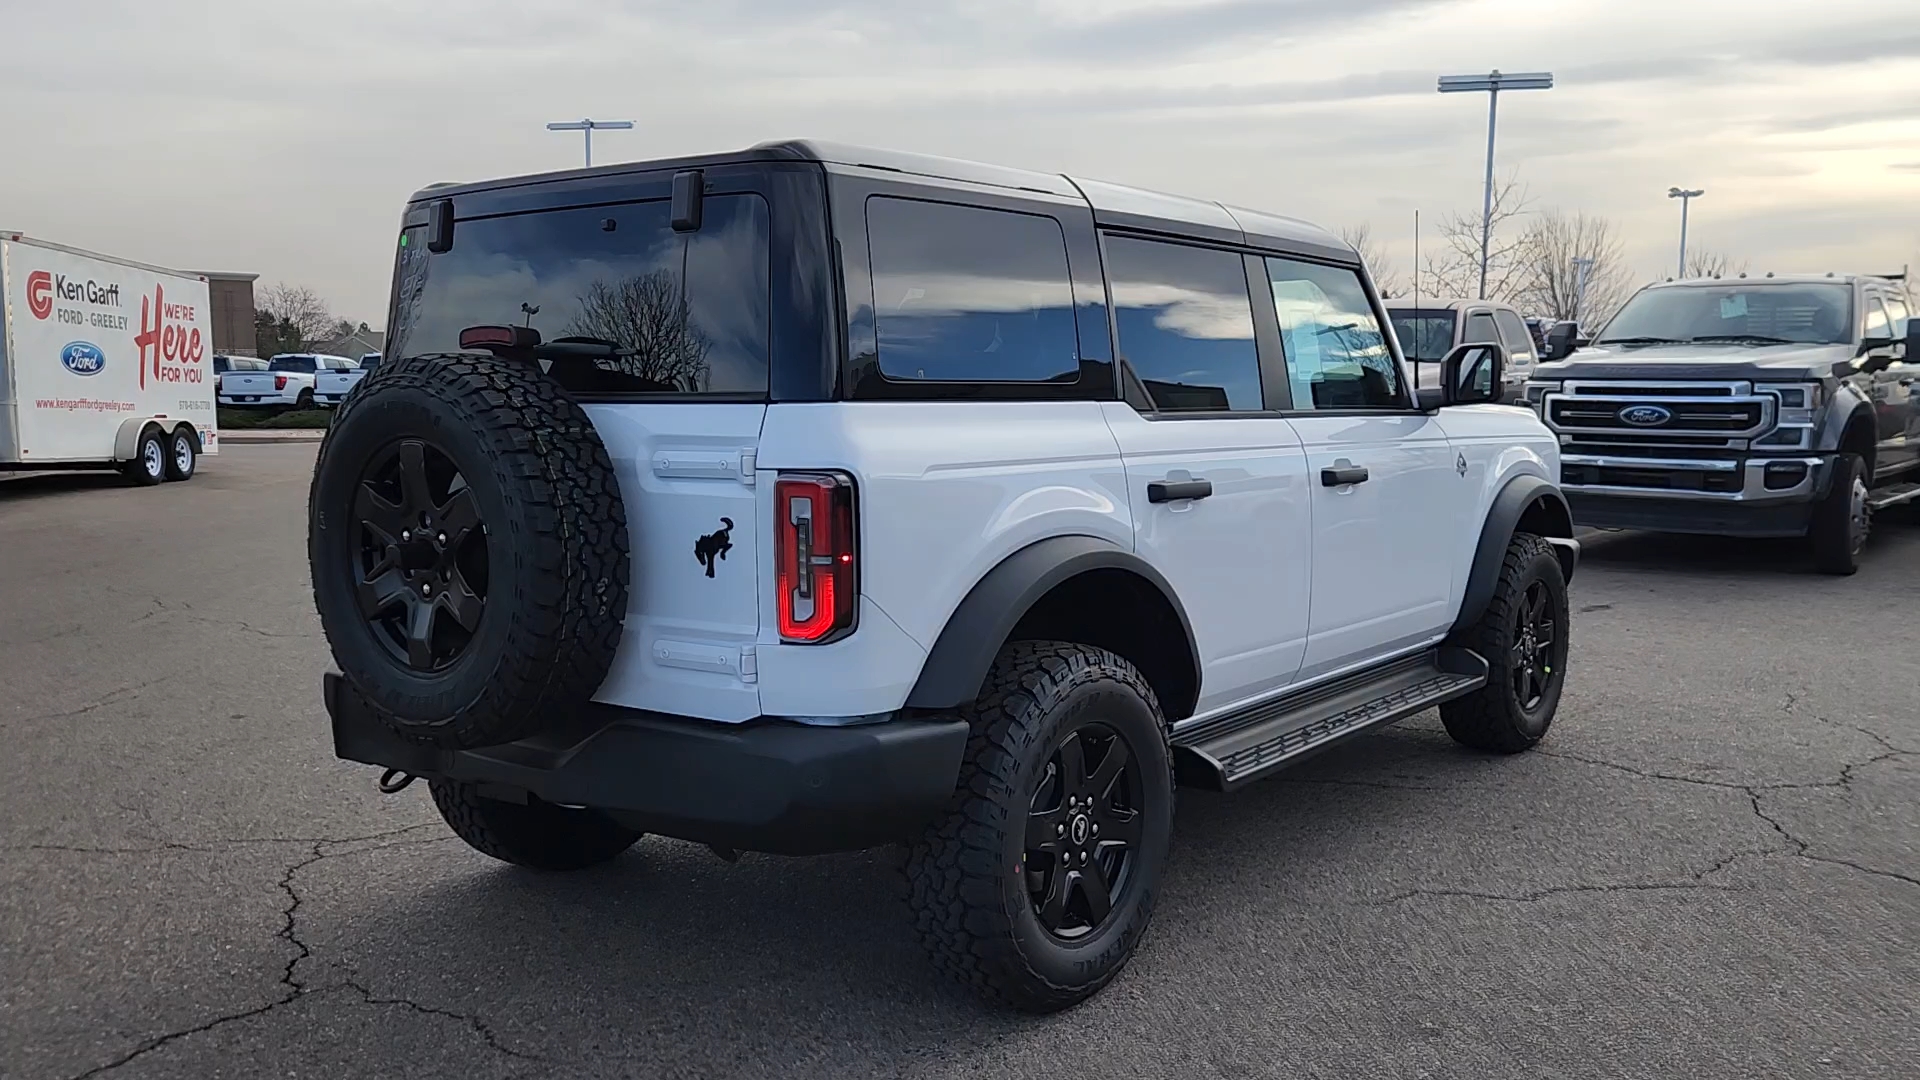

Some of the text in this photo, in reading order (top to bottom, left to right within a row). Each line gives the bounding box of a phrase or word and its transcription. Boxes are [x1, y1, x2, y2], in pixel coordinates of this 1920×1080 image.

[55, 273, 120, 307] Ken Garff
[57, 308, 84, 325] FORD
[90, 312, 128, 331] GREELEY
[164, 303, 195, 322] WE'RE
[134, 282, 204, 391] Here
[69, 346, 98, 370] Ford
[161, 367, 202, 384] FOR YOU
[1630, 409, 1659, 422] Ford
